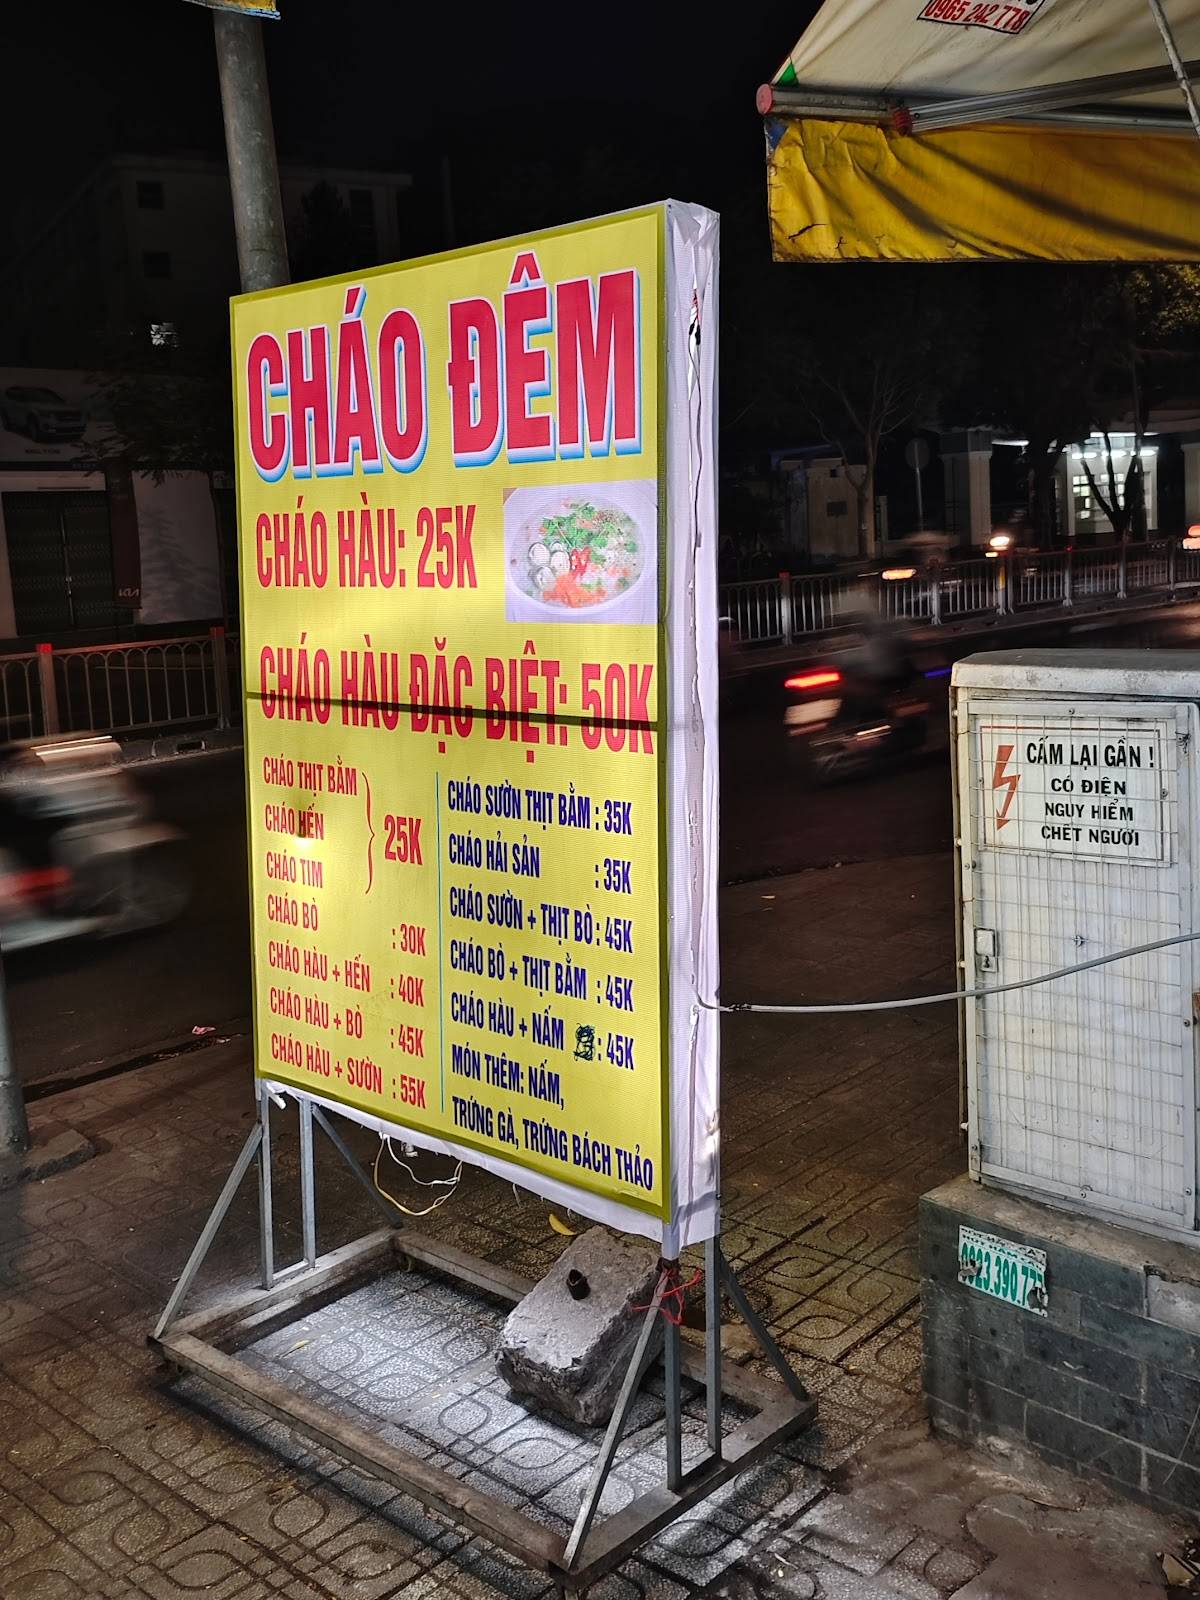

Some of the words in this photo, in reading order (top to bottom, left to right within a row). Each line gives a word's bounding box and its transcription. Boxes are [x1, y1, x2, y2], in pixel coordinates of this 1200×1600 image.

[924, 0, 970, 21] 0965
[963, 4, 1000, 24] 242
[994, 5, 1030, 31] 778
[247, 284, 428, 483] CHÁO
[447, 250, 641, 468] ĐÊM
[256, 496, 327, 588] CHÁO
[337, 492, 406, 588] HÀU:
[416, 504, 478, 589] 25K
[260, 632, 331, 724] CHÁO
[340, 634, 399, 731] HÀU
[409, 636, 473, 754] ĐẶC
[485, 640, 568, 763] BIỆT:
[581, 662, 654, 754] 50K
[263, 753, 294, 788] CHÁO
[298, 761, 324, 796] THỊT
[1026, 736, 1062, 764] CẤM
[1070, 744, 1097, 770] LẠI
[1104, 736, 1140, 768] GẦN
[1051, 775, 1074, 792] CÓ
[1081, 776, 1126, 796] ĐIỆN
[265, 802, 295, 835] CHÁO
[298, 803, 324, 840] HẾN
[448, 776, 480, 814] CHÁO
[486, 780, 521, 820] SƯỜN
[525, 790, 554, 830] THỊT
[604, 800, 632, 836] 35K
[1045, 802, 1084, 818] NGUY
[1091, 798, 1133, 820] HIỂM
[266, 849, 296, 883] CHÁO
[300, 859, 323, 888] TIM
[384, 814, 423, 866] 25K
[449, 830, 482, 868] CHÁO
[486, 830, 508, 872] HẢI
[512, 834, 540, 878] SẢN
[604, 858, 632, 894] 35K
[268, 892, 298, 926] CHÁO
[302, 898, 318, 932] BÒ
[400, 924, 426, 956] 30K
[450, 883, 482, 922] CHÁO
[488, 889, 523, 930] SƯỜN
[540, 903, 570, 946] THỊT
[574, 904, 592, 944] BÒ
[605, 916, 632, 954] 45K
[268, 940, 300, 974] CHÁO
[304, 946, 328, 982] HÀU
[344, 954, 370, 992] HẾN
[398, 974, 424, 1007] 40K
[450, 937, 483, 975] CHÁO
[488, 942, 504, 980] BÒ
[522, 955, 550, 997] THỊT
[606, 974, 634, 1012] 45K
[270, 986, 301, 1020] CHÁO
[305, 994, 329, 1029] HÀU
[346, 1004, 363, 1038] BÒ
[398, 1024, 424, 1058] 45K
[451, 990, 484, 1029] CHÁO
[488, 998, 514, 1036] HÀU
[532, 1005, 564, 1050] NẤM
[606, 1032, 634, 1070] 45K
[272, 1033, 302, 1068] CHÁO
[306, 1041, 330, 1077] HÀU
[347, 1056, 382, 1094] SƯỜN
[400, 1074, 426, 1109] 55K
[452, 1042, 480, 1081] MÓN
[484, 1052, 524, 1094] THÊM:
[528, 1060, 564, 1110] NẤM,
[452, 1096, 493, 1138] TRỨNG
[498, 1108, 518, 1149] GÀ,
[522, 1118, 568, 1161] TRỨNG
[572, 1132, 612, 1176] BÁCH
[615, 1144, 653, 1190] THẢO
